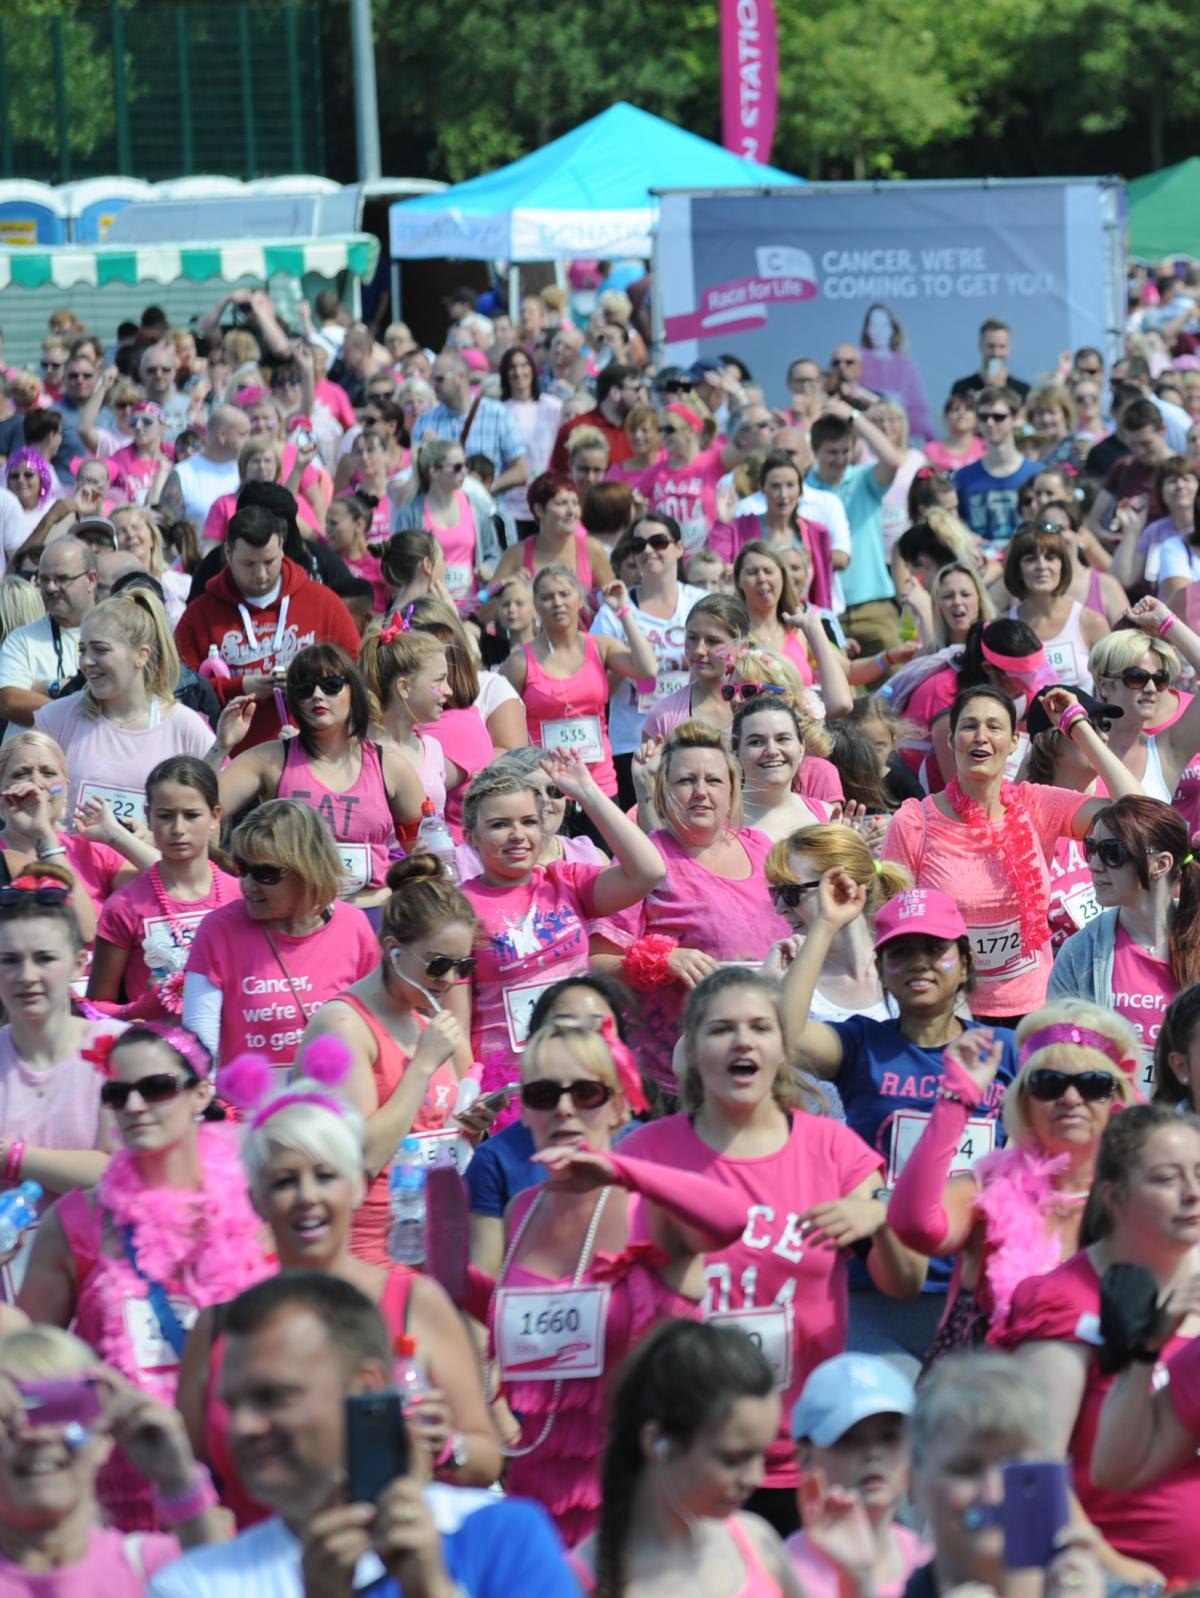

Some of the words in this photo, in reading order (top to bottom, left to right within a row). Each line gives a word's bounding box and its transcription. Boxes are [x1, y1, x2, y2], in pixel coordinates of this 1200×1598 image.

[823, 276, 917, 299] COMING
[921, 275, 950, 297] TO
[956, 274, 999, 297] GET
[560, 729, 586, 743] 535
[105, 798, 135, 818] 22
[976, 932, 1020, 954] 1772
[242, 975, 313, 996] Cancer,
[242, 1002, 297, 1023] we're
[245, 1031, 266, 1048] to
[269, 1028, 304, 1052] get
[519, 1308, 580, 1337] 1660
